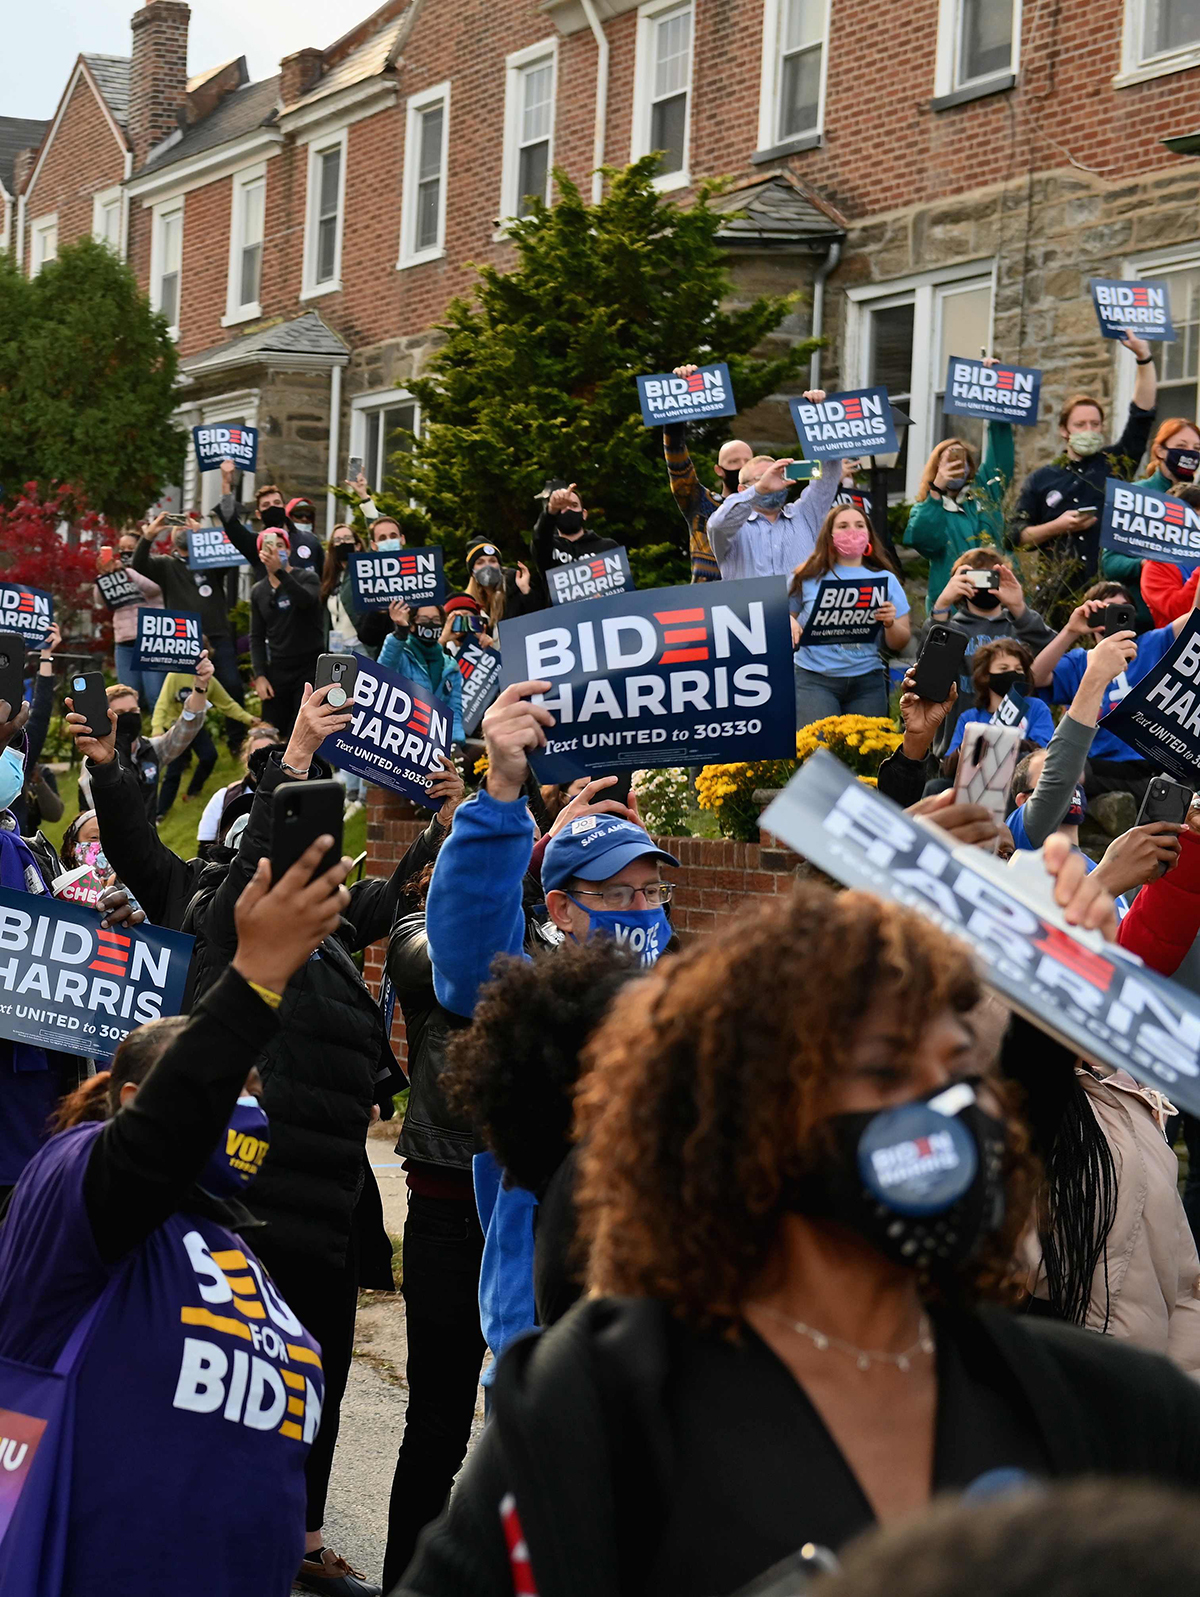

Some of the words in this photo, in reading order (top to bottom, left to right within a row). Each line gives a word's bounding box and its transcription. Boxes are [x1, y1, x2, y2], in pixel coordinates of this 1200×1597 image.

[1095, 286, 1165, 307] BIDEN
[1099, 305, 1167, 325] HARRIS
[644, 370, 723, 398] BIDEN
[953, 363, 1034, 393] BIDEN
[647, 387, 726, 412] HARRIS
[952, 382, 1033, 408] HARRIS
[666, 408, 694, 417] UNITED
[798, 395, 883, 425] BIDEN
[197, 428, 254, 446] BIDEN
[804, 417, 887, 442] HARRIS
[200, 443, 254, 459] HARRIS
[826, 441, 854, 450] UNITED
[1128, 536, 1163, 552] UNITED
[356, 554, 436, 578] BIDEN
[553, 554, 622, 590] BIDEN
[98, 570, 128, 590] BID
[358, 573, 437, 594] HARRIS
[556, 571, 626, 603] HARRIS
[376, 595, 405, 603] UNITED
[411, 591, 434, 600] 30330
[820, 586, 885, 608] BIDEN
[142, 615, 199, 639] BIDEN
[812, 610, 878, 626] HARRIS
[140, 637, 201, 657] HARRIS
[525, 601, 767, 681] BIDEN
[462, 653, 496, 712] ARRIS
[529, 663, 772, 724] HARRIS
[354, 670, 448, 748] BIDEN
[470, 687, 488, 712] UNITED
[350, 711, 445, 773] HARRIS
[543, 737, 578, 756] Text
[581, 728, 667, 750] UNITED
[671, 726, 689, 742] to
[693, 719, 762, 740] 30330
[1131, 710, 1151, 728] Text
[1148, 722, 1188, 754] UNITED
[1183, 749, 1194, 760] to
[335, 738, 354, 754] Text
[354, 746, 393, 770] UNITED
[393, 766, 402, 775] to
[402, 768, 434, 788] 30330
[581, 830, 606, 847] SAVE
[614, 922, 660, 952] VOTE
[15, 1005, 80, 1030] UNITED
[83, 1020, 96, 1035] to
[182, 1231, 303, 1337] SEIU
[248, 1322, 290, 1364] FOR
[172, 1338, 324, 1445] BIDEN
